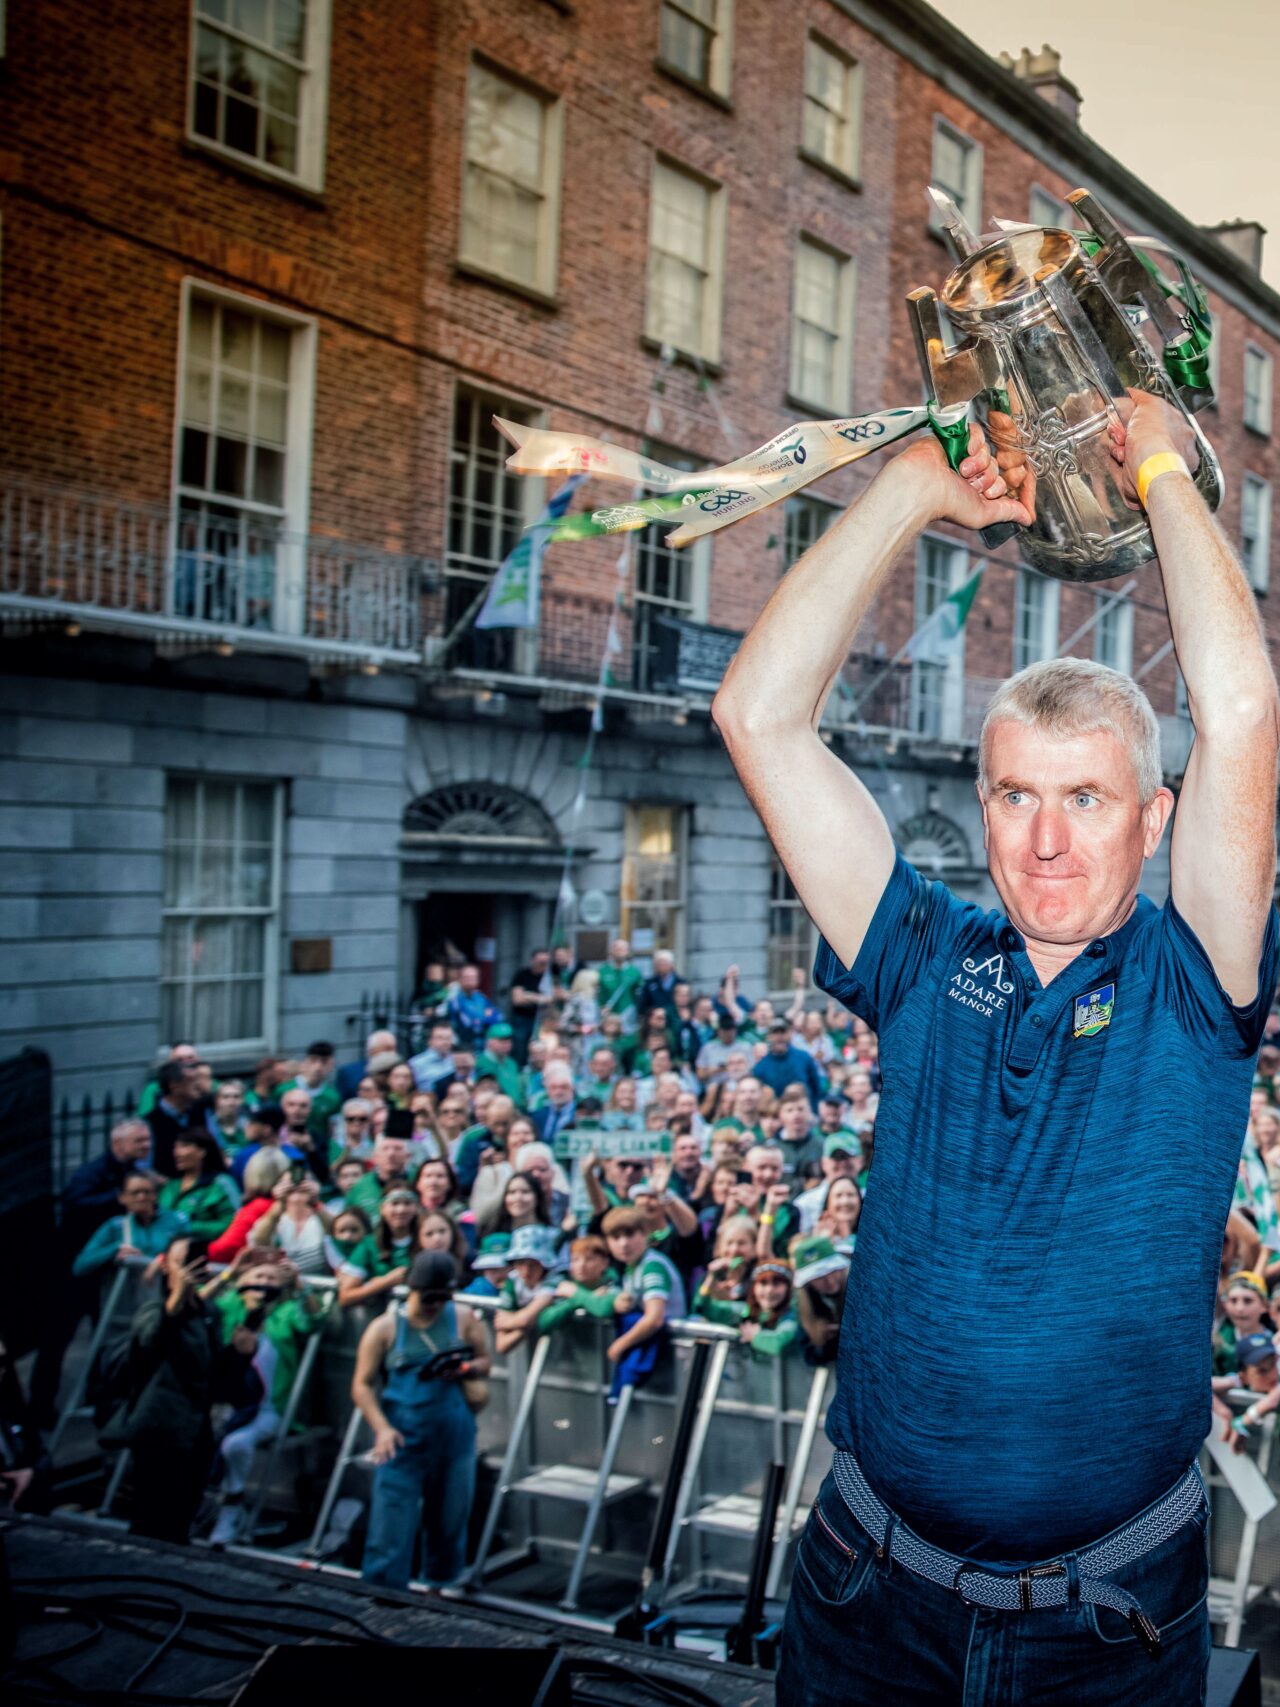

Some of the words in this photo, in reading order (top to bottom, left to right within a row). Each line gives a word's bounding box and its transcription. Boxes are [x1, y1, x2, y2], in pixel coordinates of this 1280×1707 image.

[700, 489, 749, 512] GAA
[712, 495, 756, 518] HURLING
[948, 987, 993, 1018] MANOR
[950, 973, 1007, 1010] ADARE
